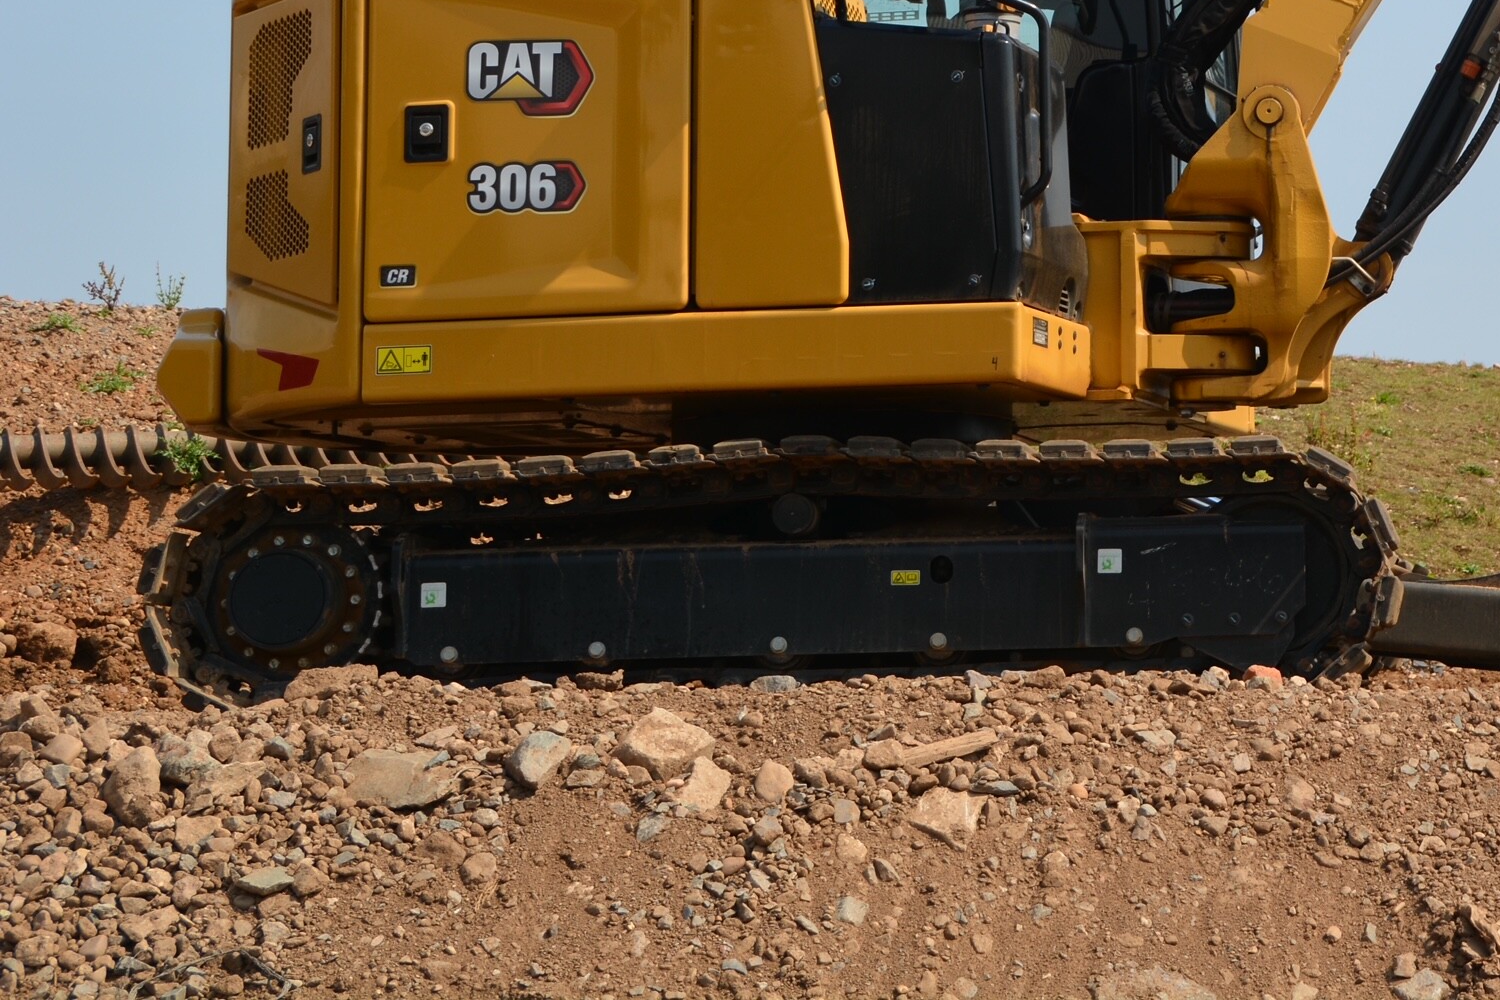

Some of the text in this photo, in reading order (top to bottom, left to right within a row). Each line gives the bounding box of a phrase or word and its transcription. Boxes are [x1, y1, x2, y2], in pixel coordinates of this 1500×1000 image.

[468, 42, 562, 99] CAT
[469, 163, 557, 211] 306
[387, 269, 409, 284] CR
